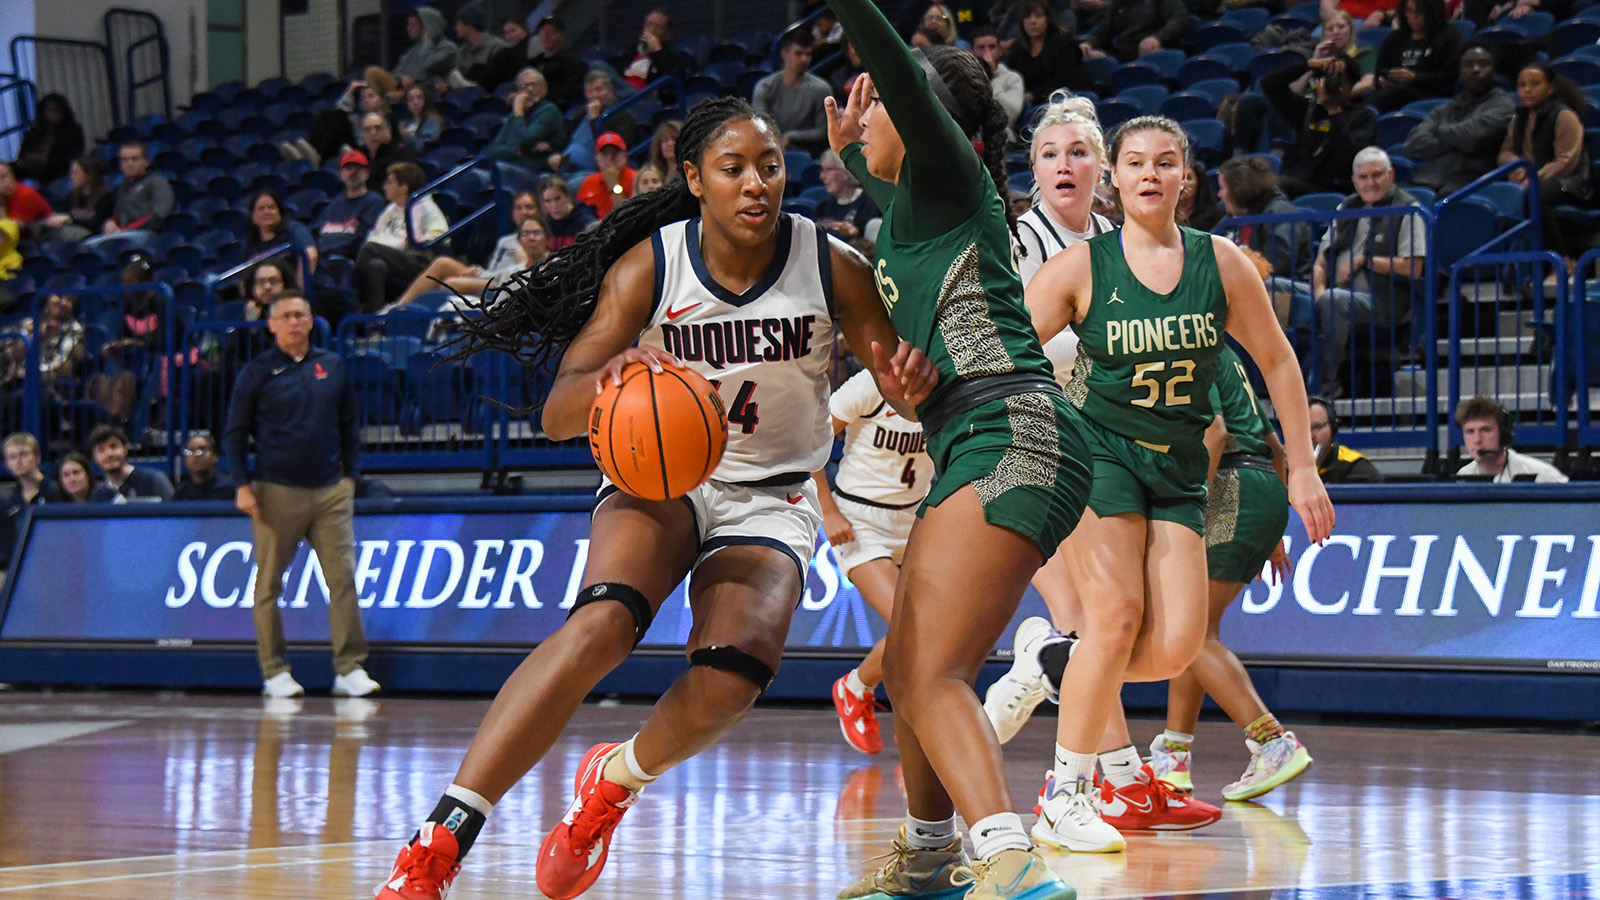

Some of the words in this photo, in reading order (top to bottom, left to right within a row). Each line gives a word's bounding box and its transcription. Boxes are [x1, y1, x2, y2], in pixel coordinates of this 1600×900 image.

[661, 315, 815, 370] DUQUESNE
[1107, 313, 1218, 355] PIONEERS
[709, 379, 759, 434] 4
[1131, 360, 1197, 408] 52
[901, 457, 916, 489] 4
